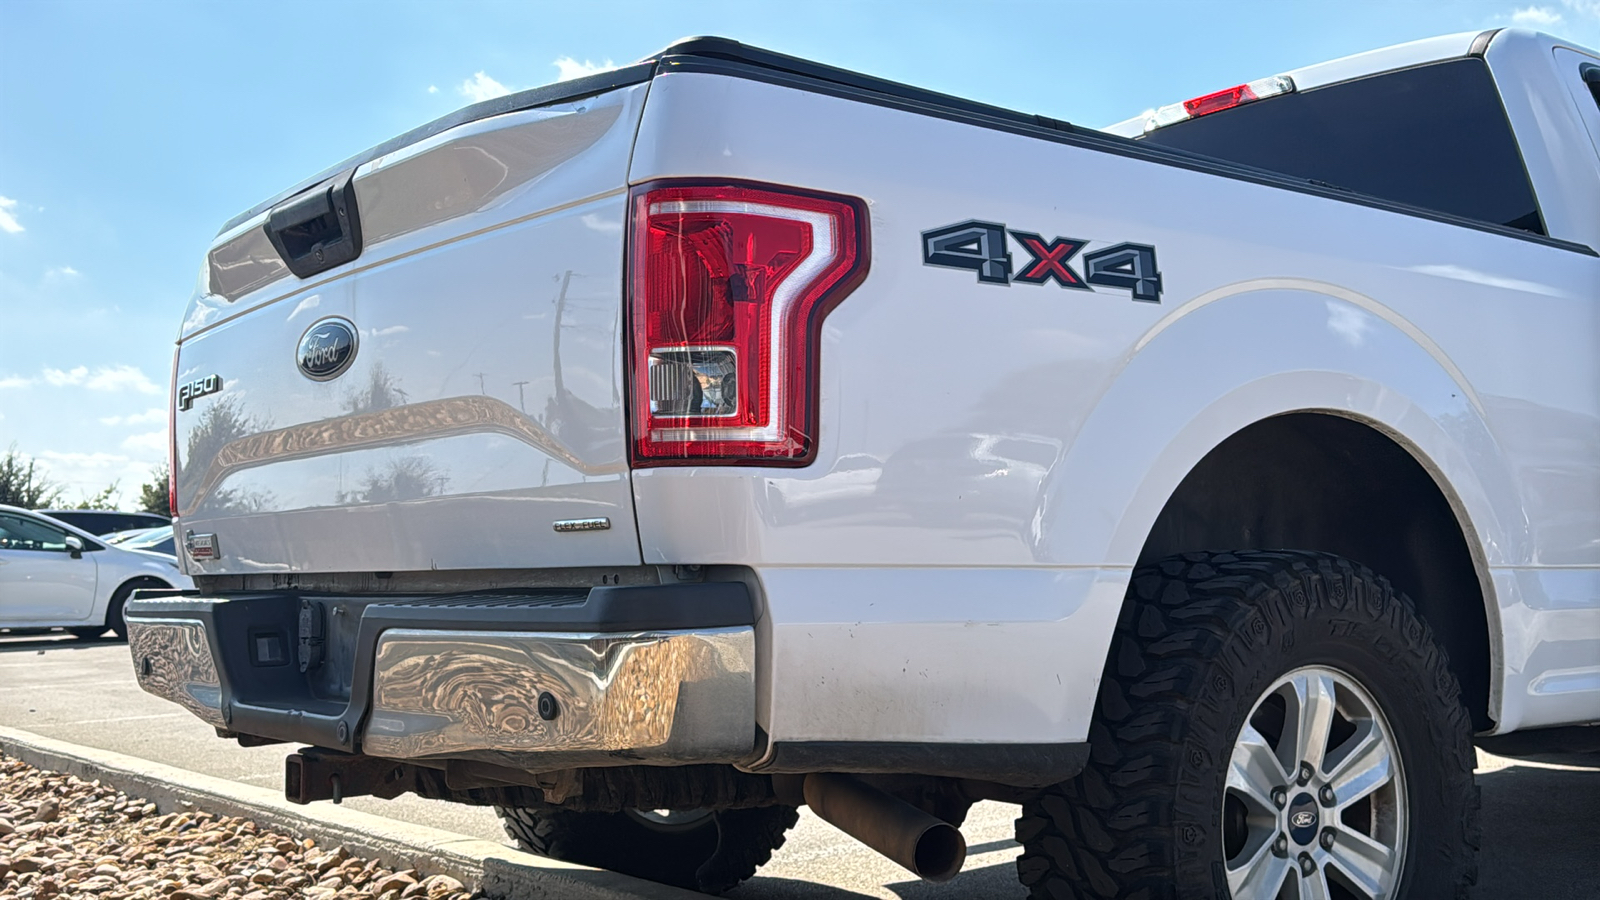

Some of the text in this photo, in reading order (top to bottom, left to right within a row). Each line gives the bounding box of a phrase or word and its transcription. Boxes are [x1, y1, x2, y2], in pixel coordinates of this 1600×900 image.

[304, 332, 340, 369] Ford
[178, 374, 221, 411] F150
[555, 520, 606, 530] FLEX FUEL
[1296, 813, 1313, 825] Ford
